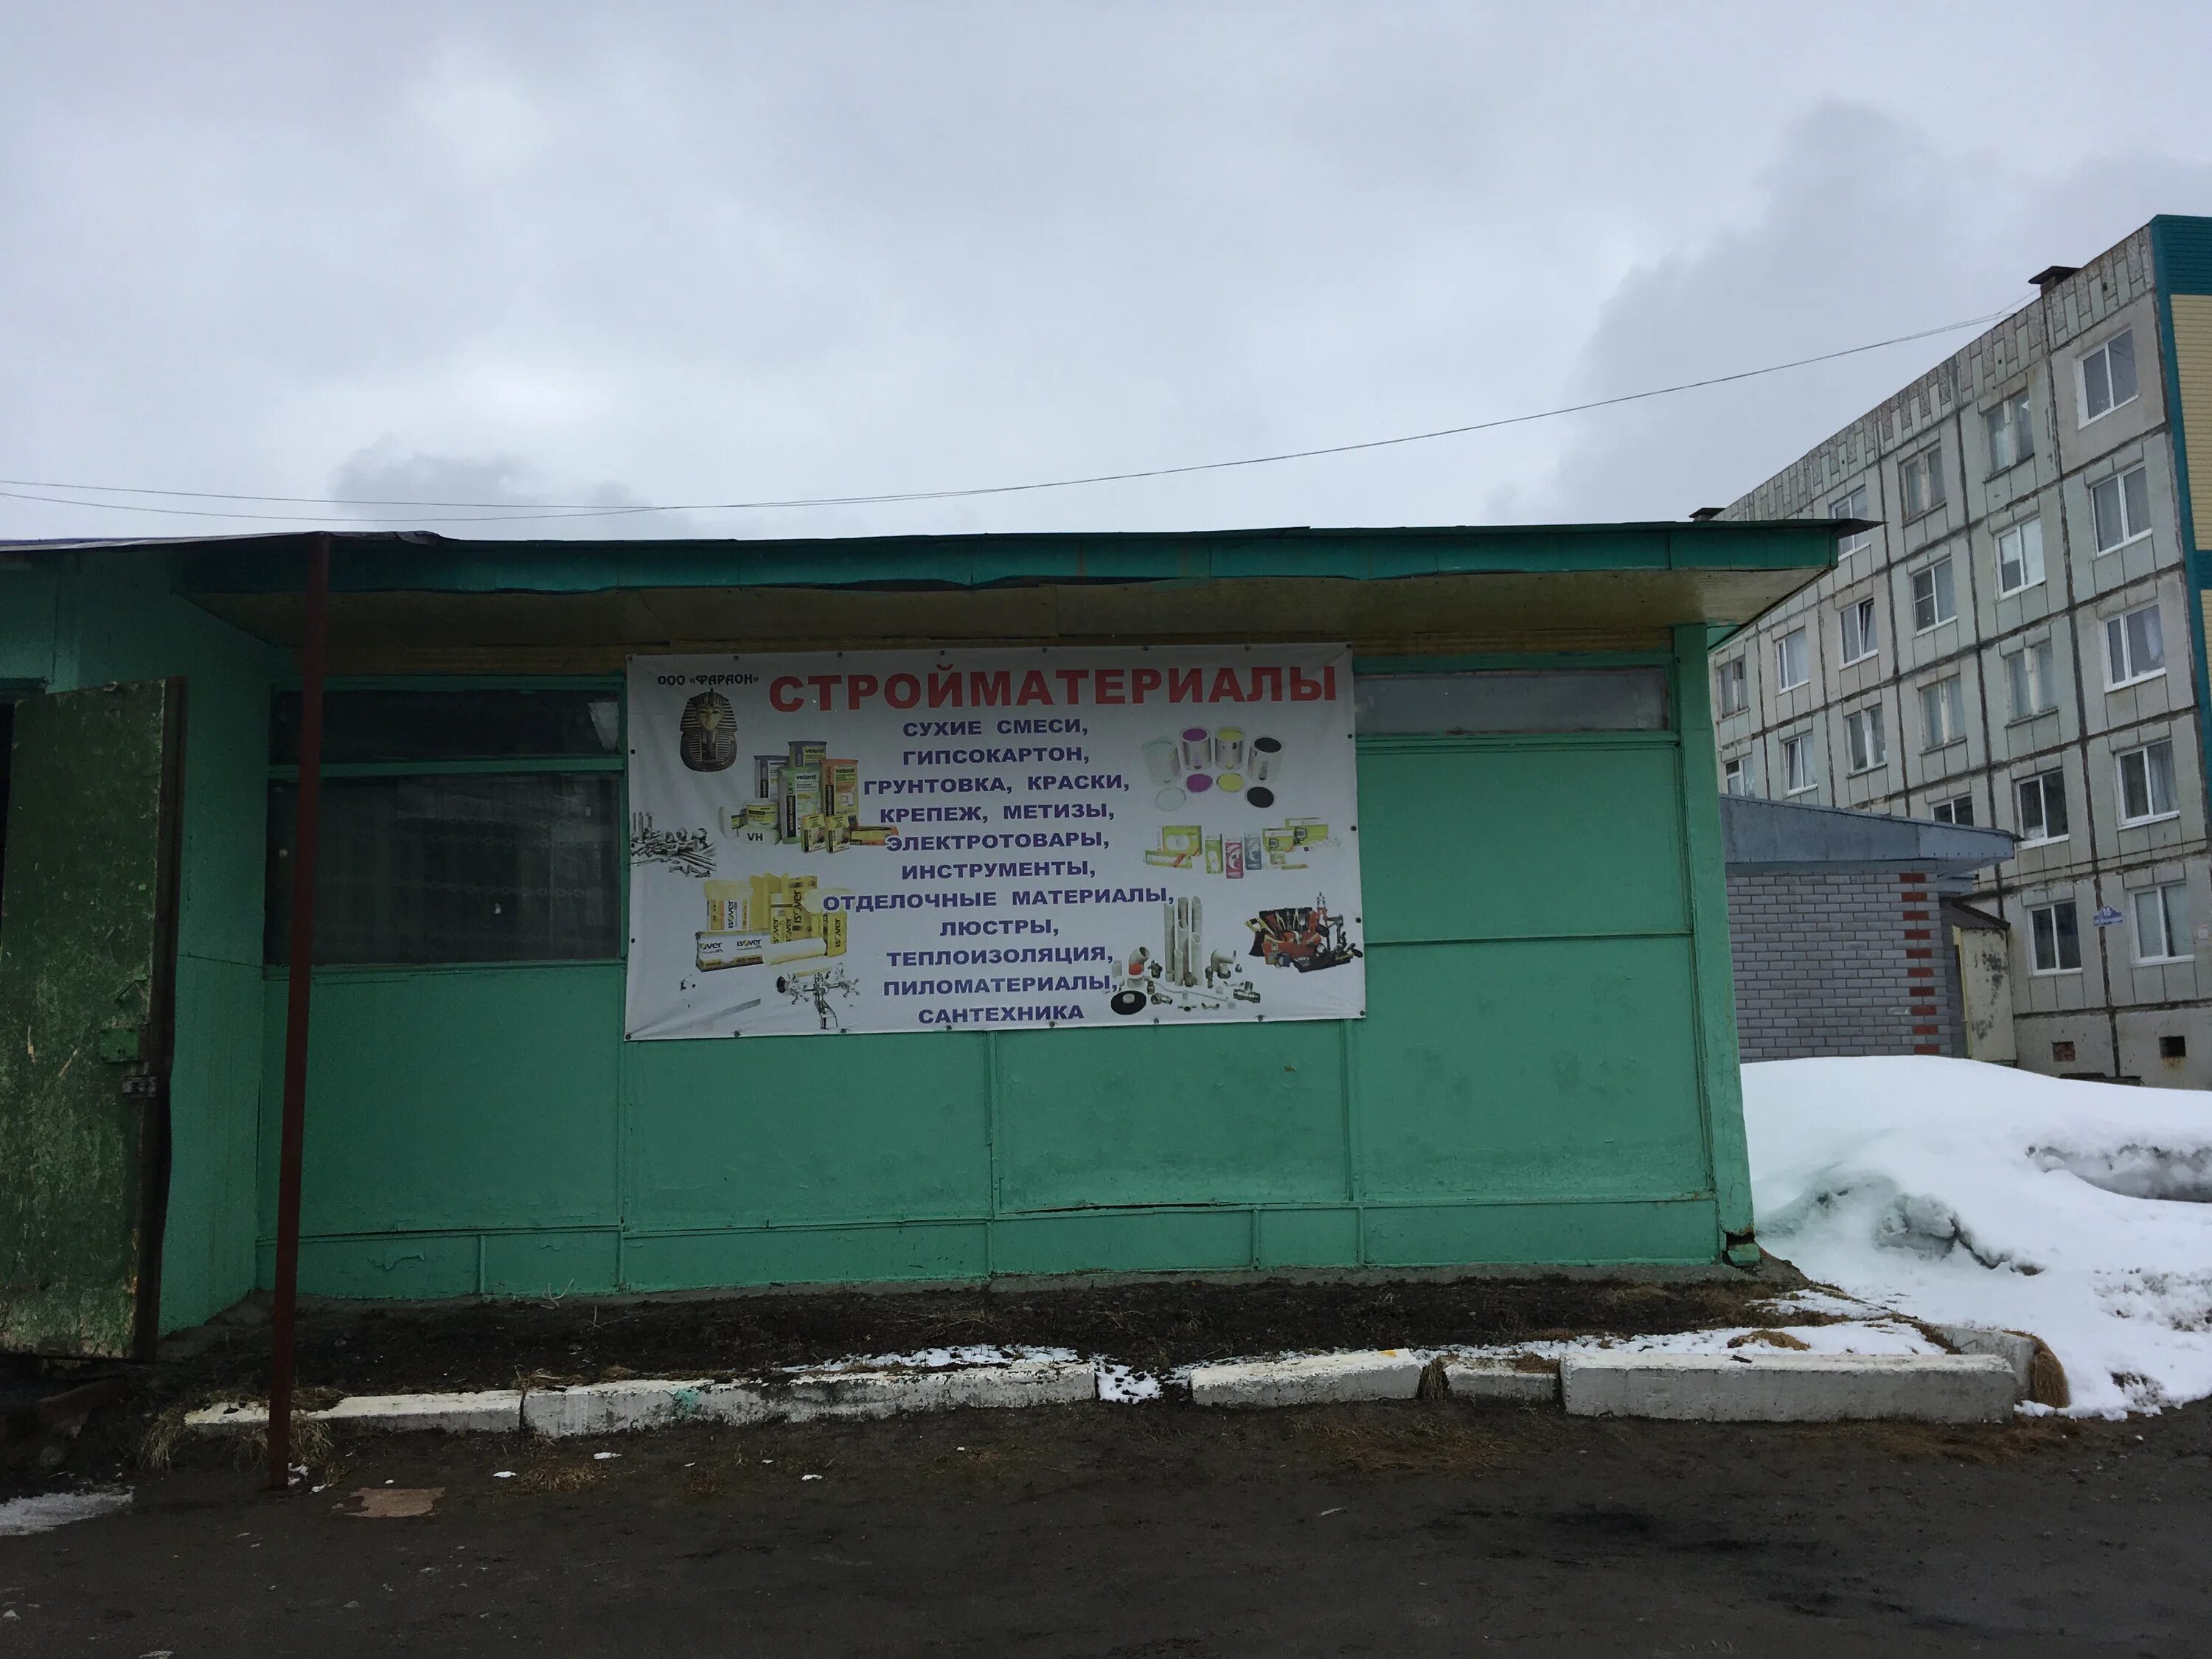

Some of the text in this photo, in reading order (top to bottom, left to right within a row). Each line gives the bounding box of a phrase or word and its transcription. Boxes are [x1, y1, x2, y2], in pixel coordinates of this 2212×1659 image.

[657, 673, 759, 686] ООО «ФАРАОН»
[769, 664, 1336, 712] СТРОЙМАТЕРИАЛЫ
[902, 718, 1088, 737] СУХИЕ СМЕСИ,
[902, 746, 1090, 765] ГИПСОКАРТОН,
[864, 777, 1012, 795] ГРУНТОВКА,
[1028, 773, 1130, 793] КРАСКИ,
[880, 802, 1114, 824] КРЕПЕЖ, МЕТИЗЫ,
[886, 831, 1110, 852] ЭЛЕКТРОТОВАРЫ,
[902, 860, 1096, 880] ИНСТРУМЕНТЫ,
[823, 887, 1175, 913] ОТДЕЛОЧНЫЕ МАТЕРИАЛЫ,
[940, 919, 1059, 937] ЛЮСТРЫ,
[887, 946, 1114, 967] ТЕПЛОИЗОЛЯЦИЯ,
[885, 975, 1119, 996] ПИЛОМАТЕРИАЛЫ,
[919, 1004, 1084, 1024] САНТЕХНИКА
